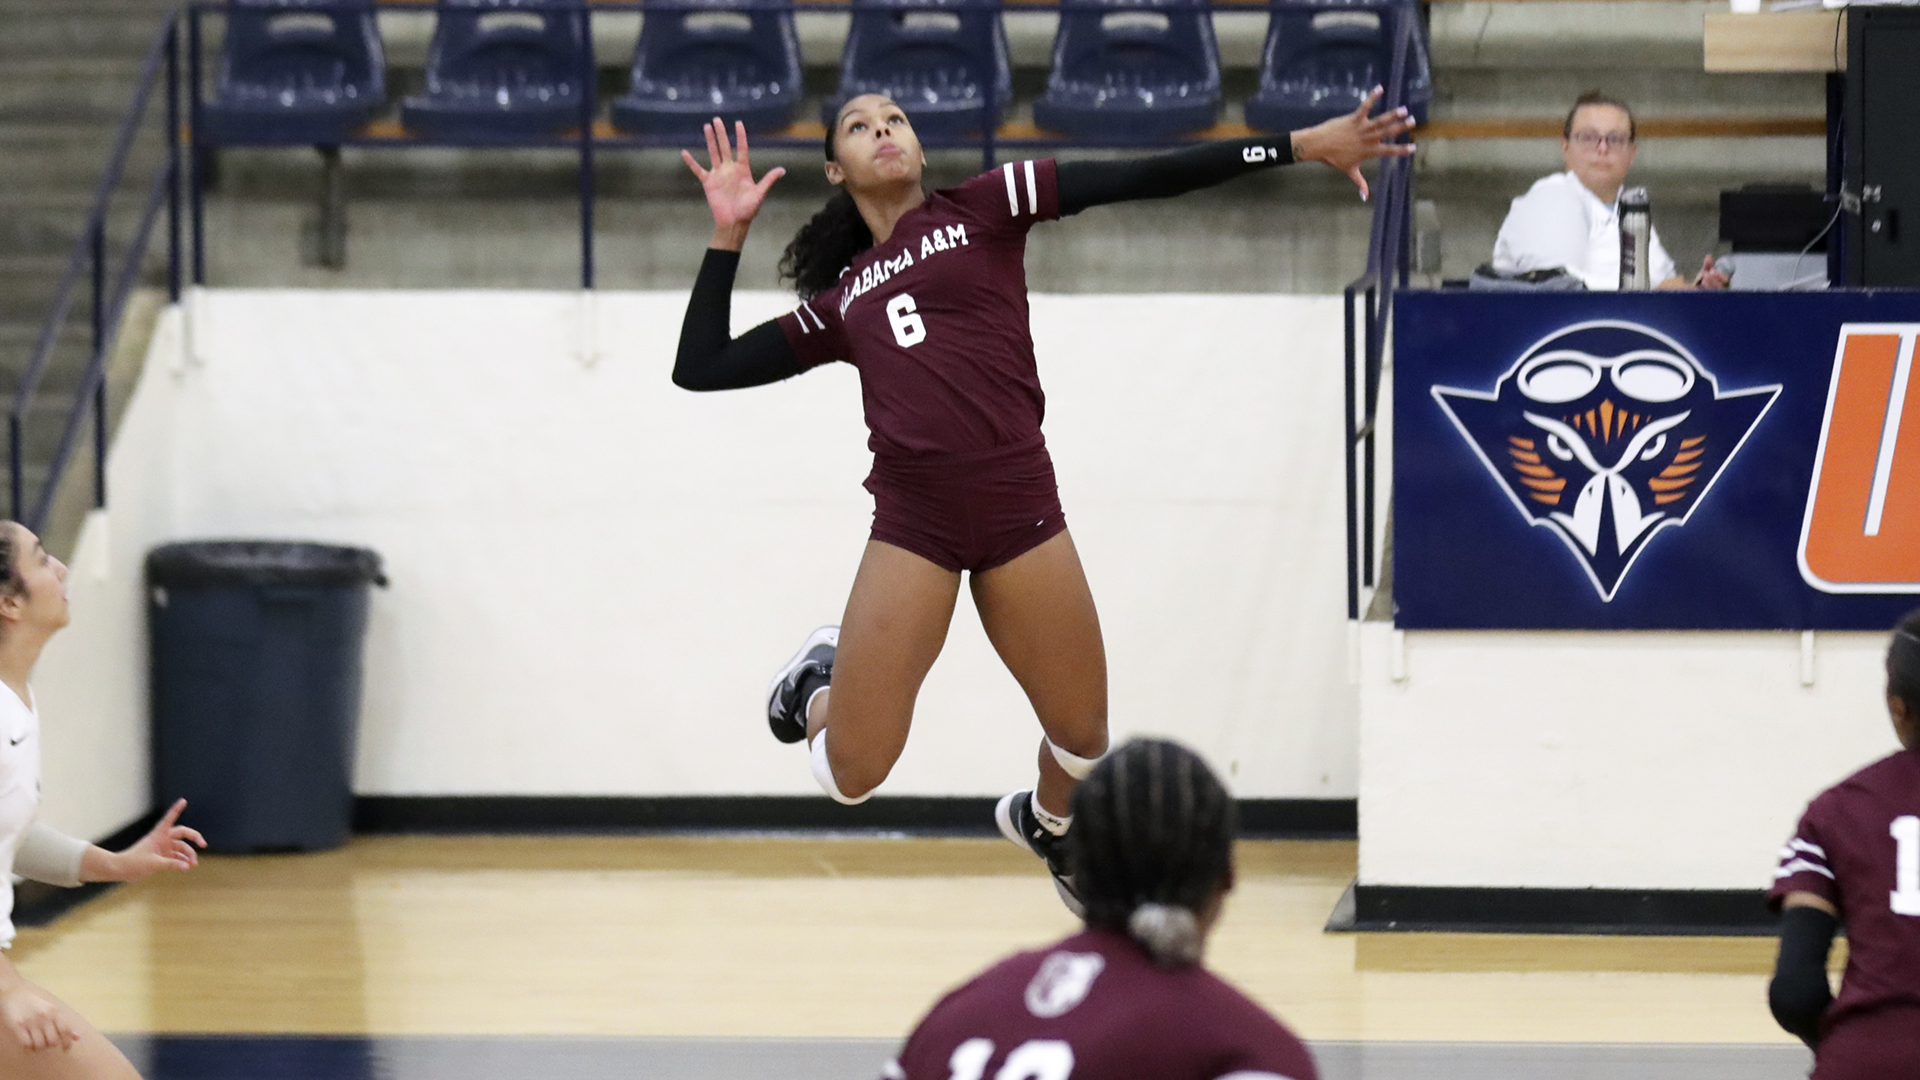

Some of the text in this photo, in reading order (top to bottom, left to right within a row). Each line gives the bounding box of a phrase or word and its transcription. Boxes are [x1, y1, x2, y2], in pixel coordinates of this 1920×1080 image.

[1242, 146, 1266, 163] 6
[920, 223, 969, 260] A&M
[886, 292, 927, 348] 6
